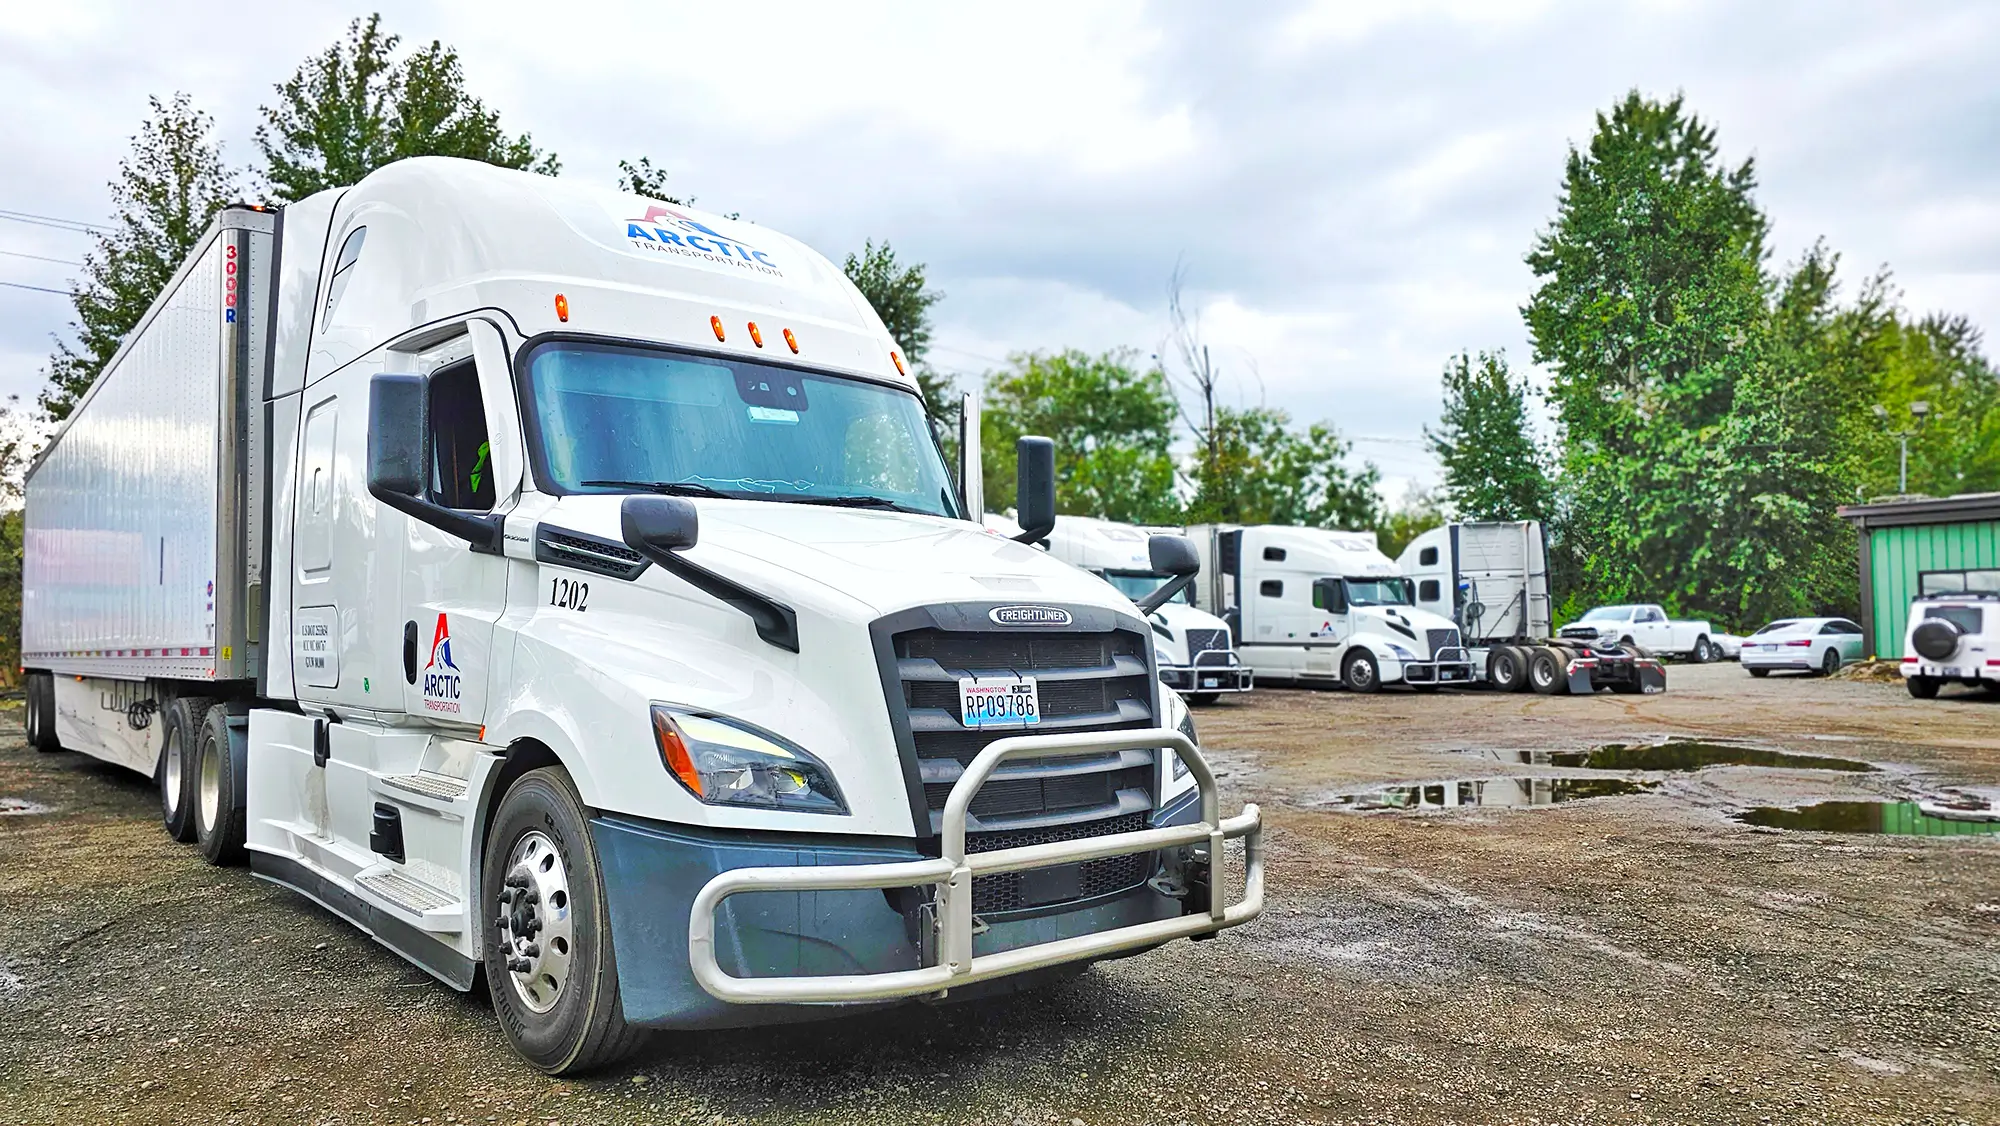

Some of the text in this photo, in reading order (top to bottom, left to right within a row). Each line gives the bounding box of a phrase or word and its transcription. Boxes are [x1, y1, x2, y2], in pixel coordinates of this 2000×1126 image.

[627, 223, 777, 268] ARCTIC
[631, 240, 783, 278] TRANSPORTATION
[225, 245, 237, 323] 3000R
[550, 577, 589, 612] 1202
[1000, 610, 1065, 620] FREIGHTLINER
[424, 674, 461, 699] ARCTIC
[424, 699, 461, 713] TRANSPORTATION
[966, 695, 1034, 718] RP09786
[486, 917, 527, 1041] BRIDGESTO
